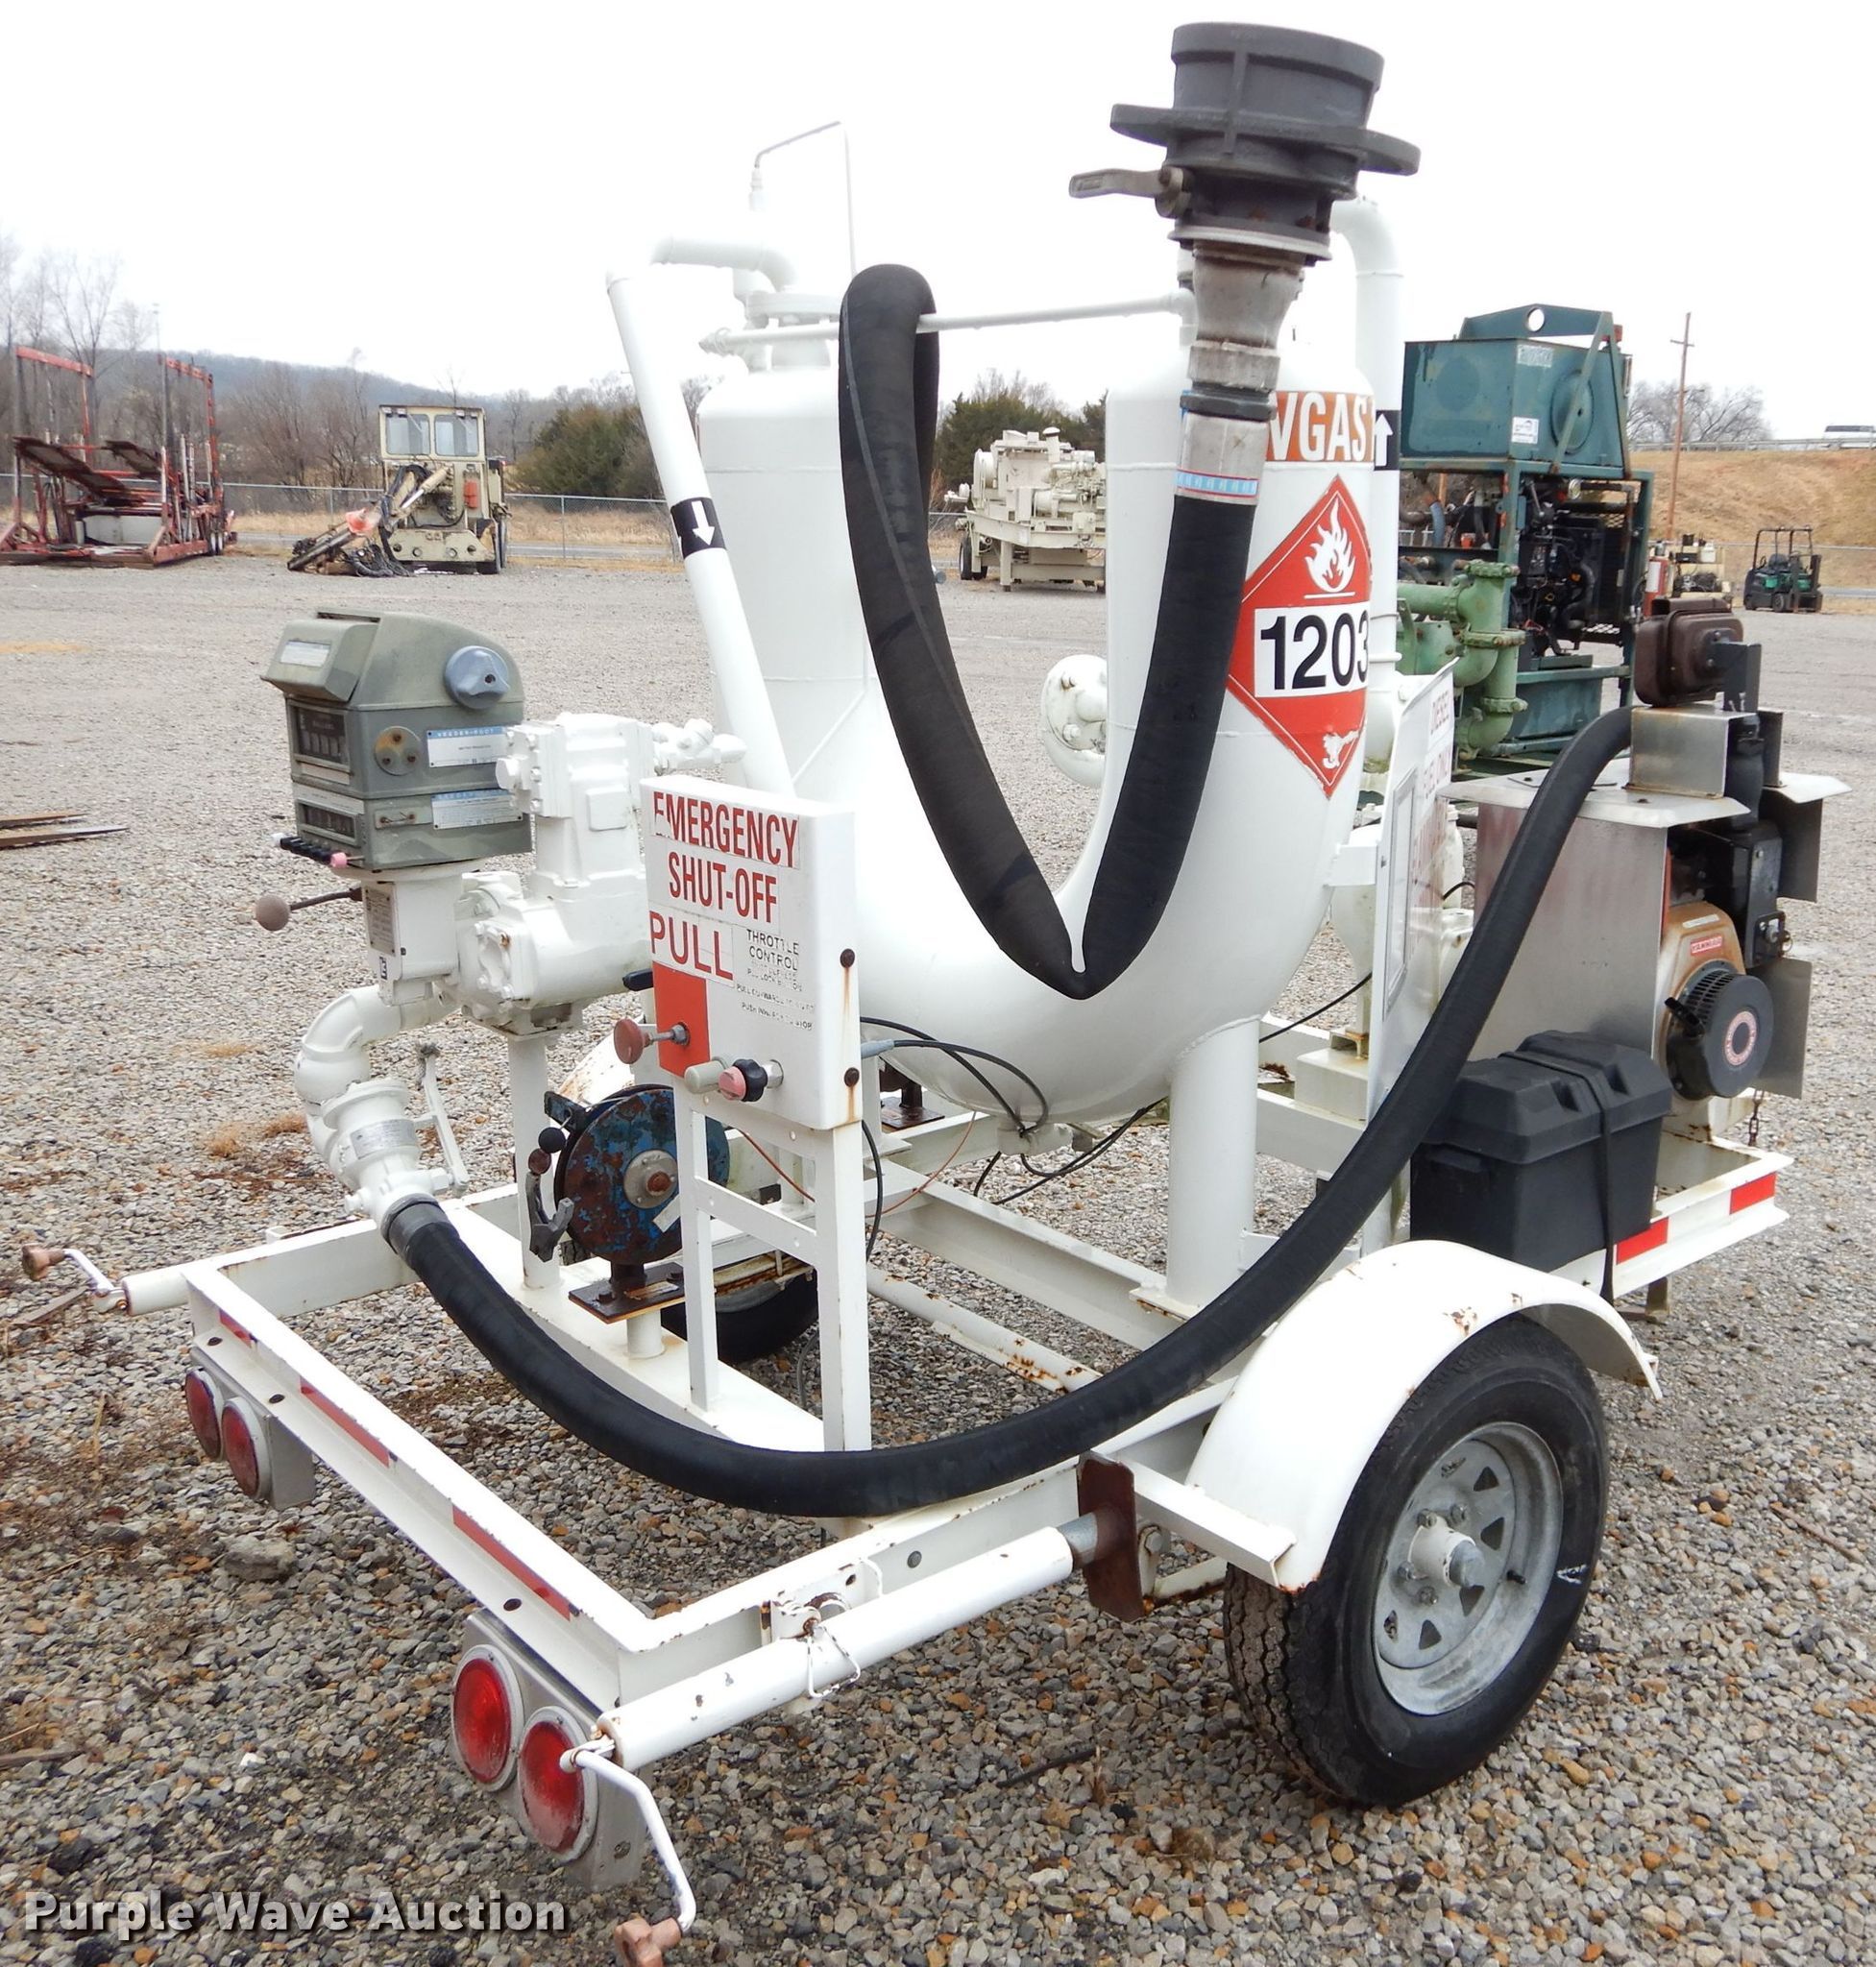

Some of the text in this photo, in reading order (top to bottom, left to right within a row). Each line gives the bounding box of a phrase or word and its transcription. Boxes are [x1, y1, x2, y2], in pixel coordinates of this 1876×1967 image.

[1268, 392, 1368, 461] VGAS
[1260, 610, 1368, 691] 1203
[653, 791, 797, 868] EMERGENCY
[669, 852, 776, 923] SHUT-OFF
[649, 911, 733, 981] PULL
[746, 928, 799, 956] THROTTLE
[749, 946, 798, 971] CONTROL
